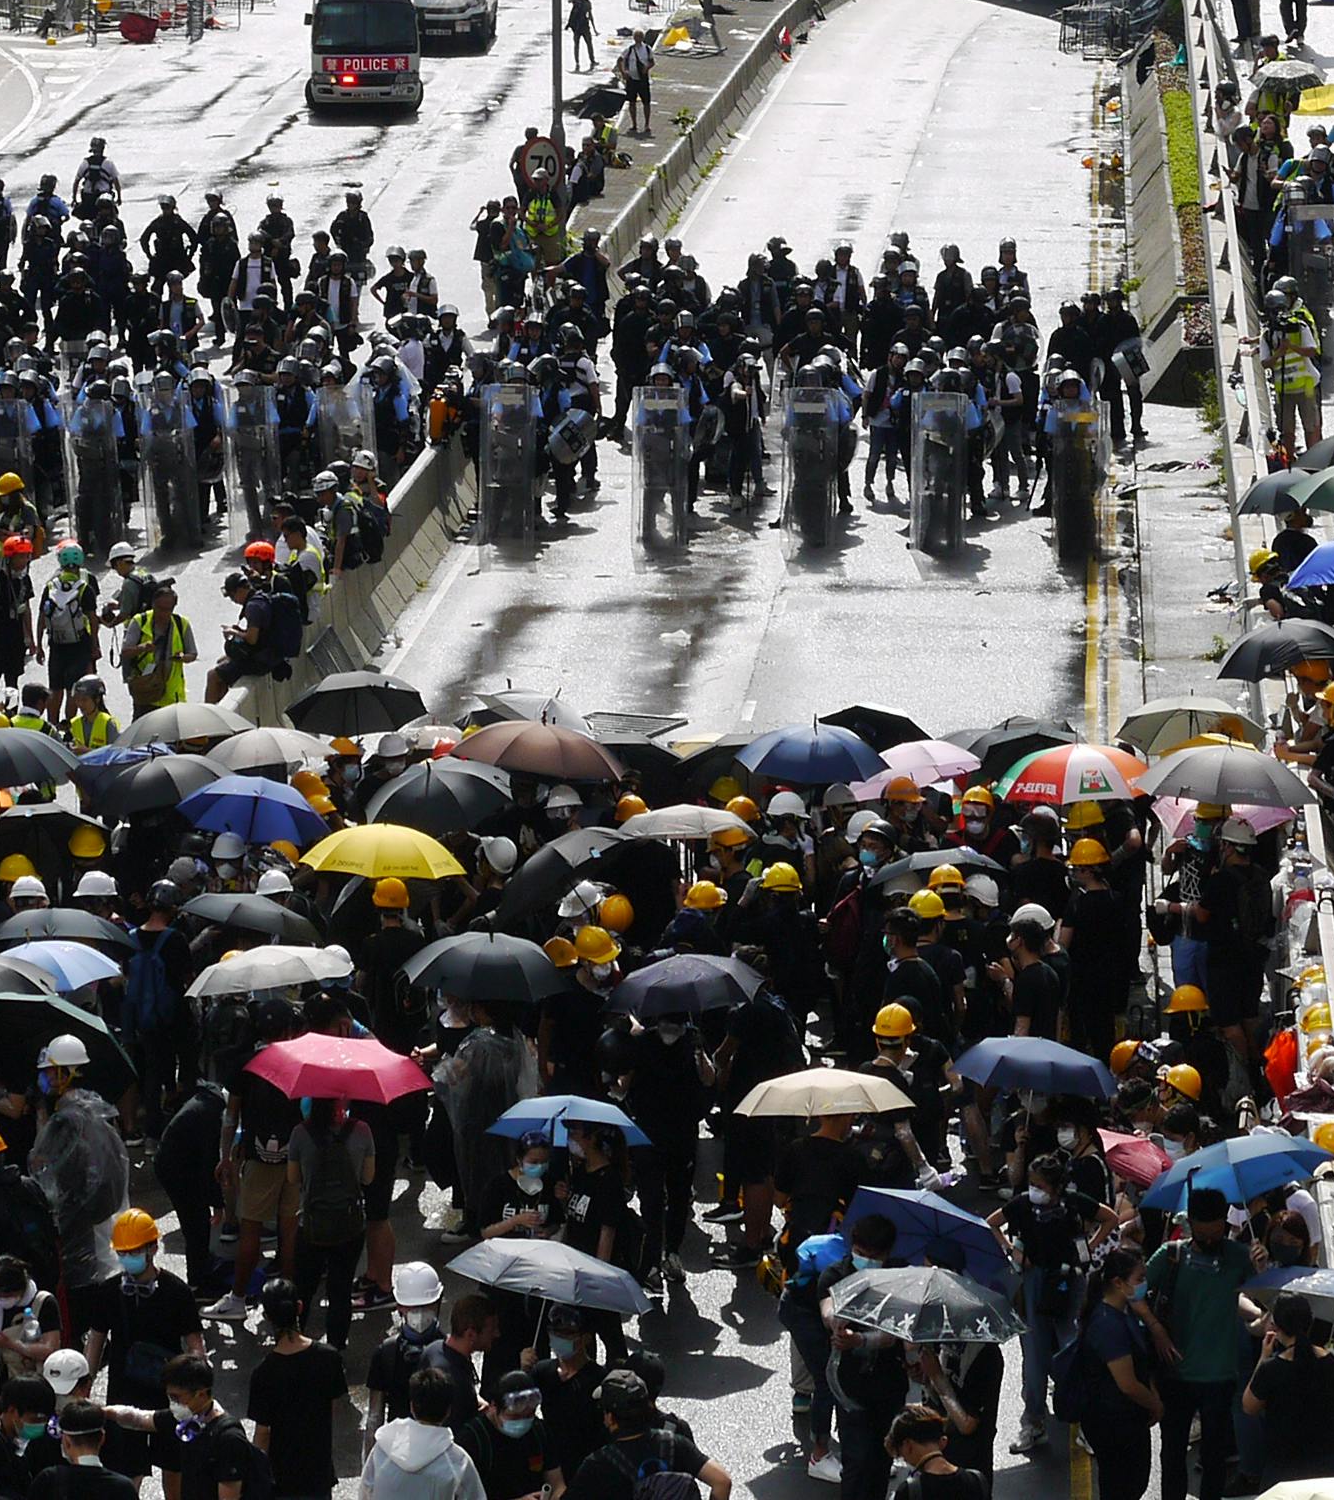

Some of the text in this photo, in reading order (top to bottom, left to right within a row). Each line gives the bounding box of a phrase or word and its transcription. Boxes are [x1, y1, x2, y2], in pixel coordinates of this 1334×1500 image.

[343, 59, 389, 71] POLICE
[530, 155, 556, 177] 70
[1015, 782, 1057, 795] 7-ELEVEN
